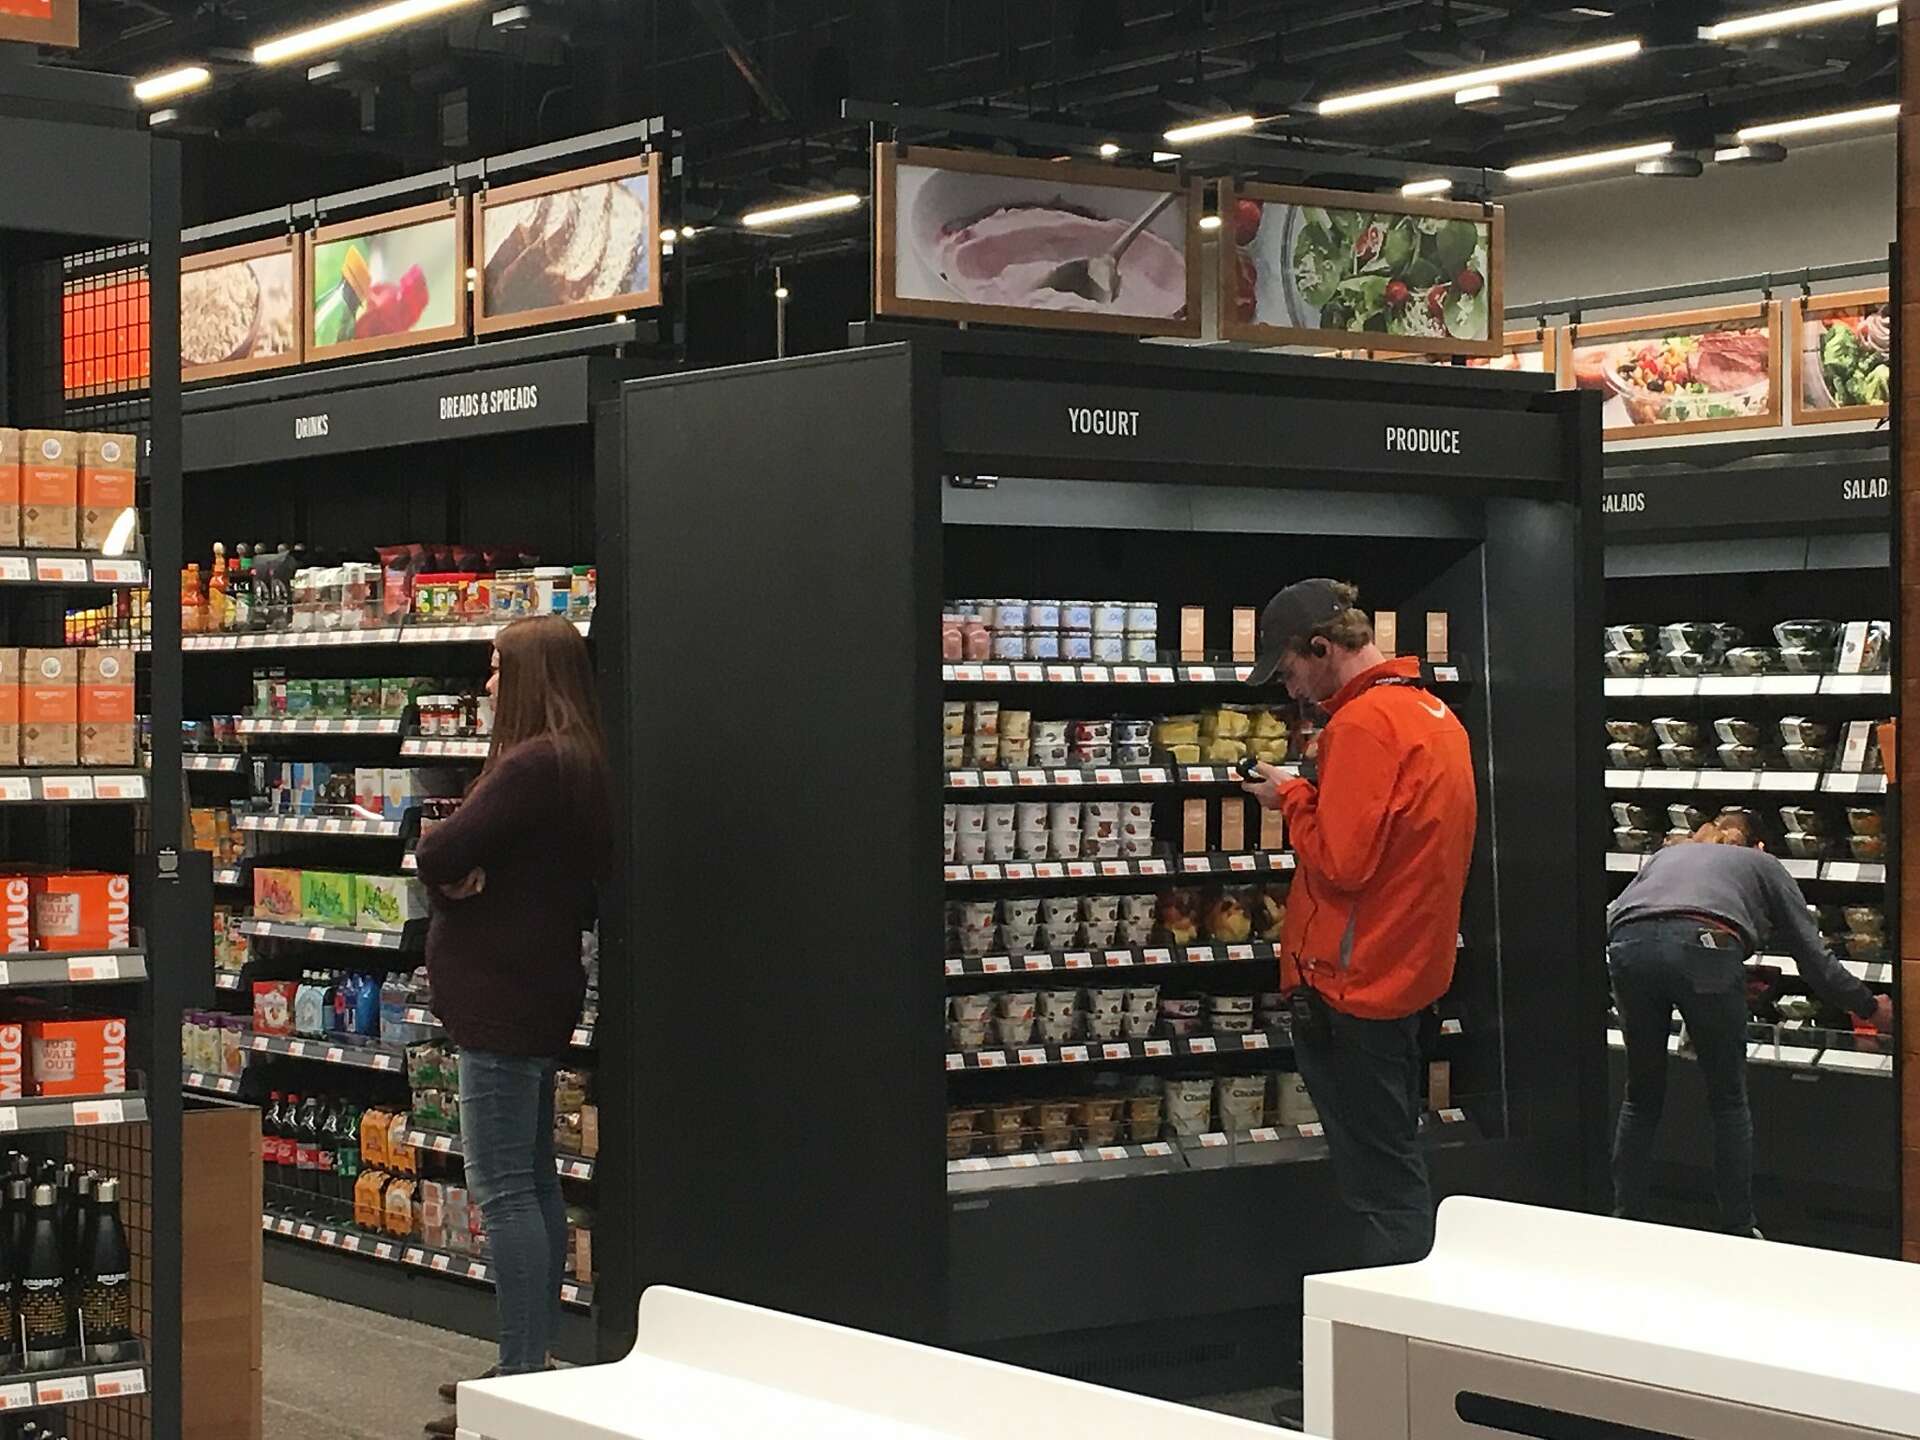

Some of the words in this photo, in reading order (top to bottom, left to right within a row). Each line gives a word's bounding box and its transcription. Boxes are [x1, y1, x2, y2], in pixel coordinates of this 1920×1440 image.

[440, 393, 479, 420] BREADS
[481, 392, 489, 415] &
[490, 386, 537, 413] SPREADS
[295, 414, 329, 440] DRINKS
[1068, 407, 1140, 437] YOGURT
[1385, 426, 1461, 455] PRODUCE
[1843, 479, 1890, 500] SALAD
[6, 878, 29, 953] MUG
[107, 874, 129, 949] MUG
[102, 1020, 126, 1094] MUG
